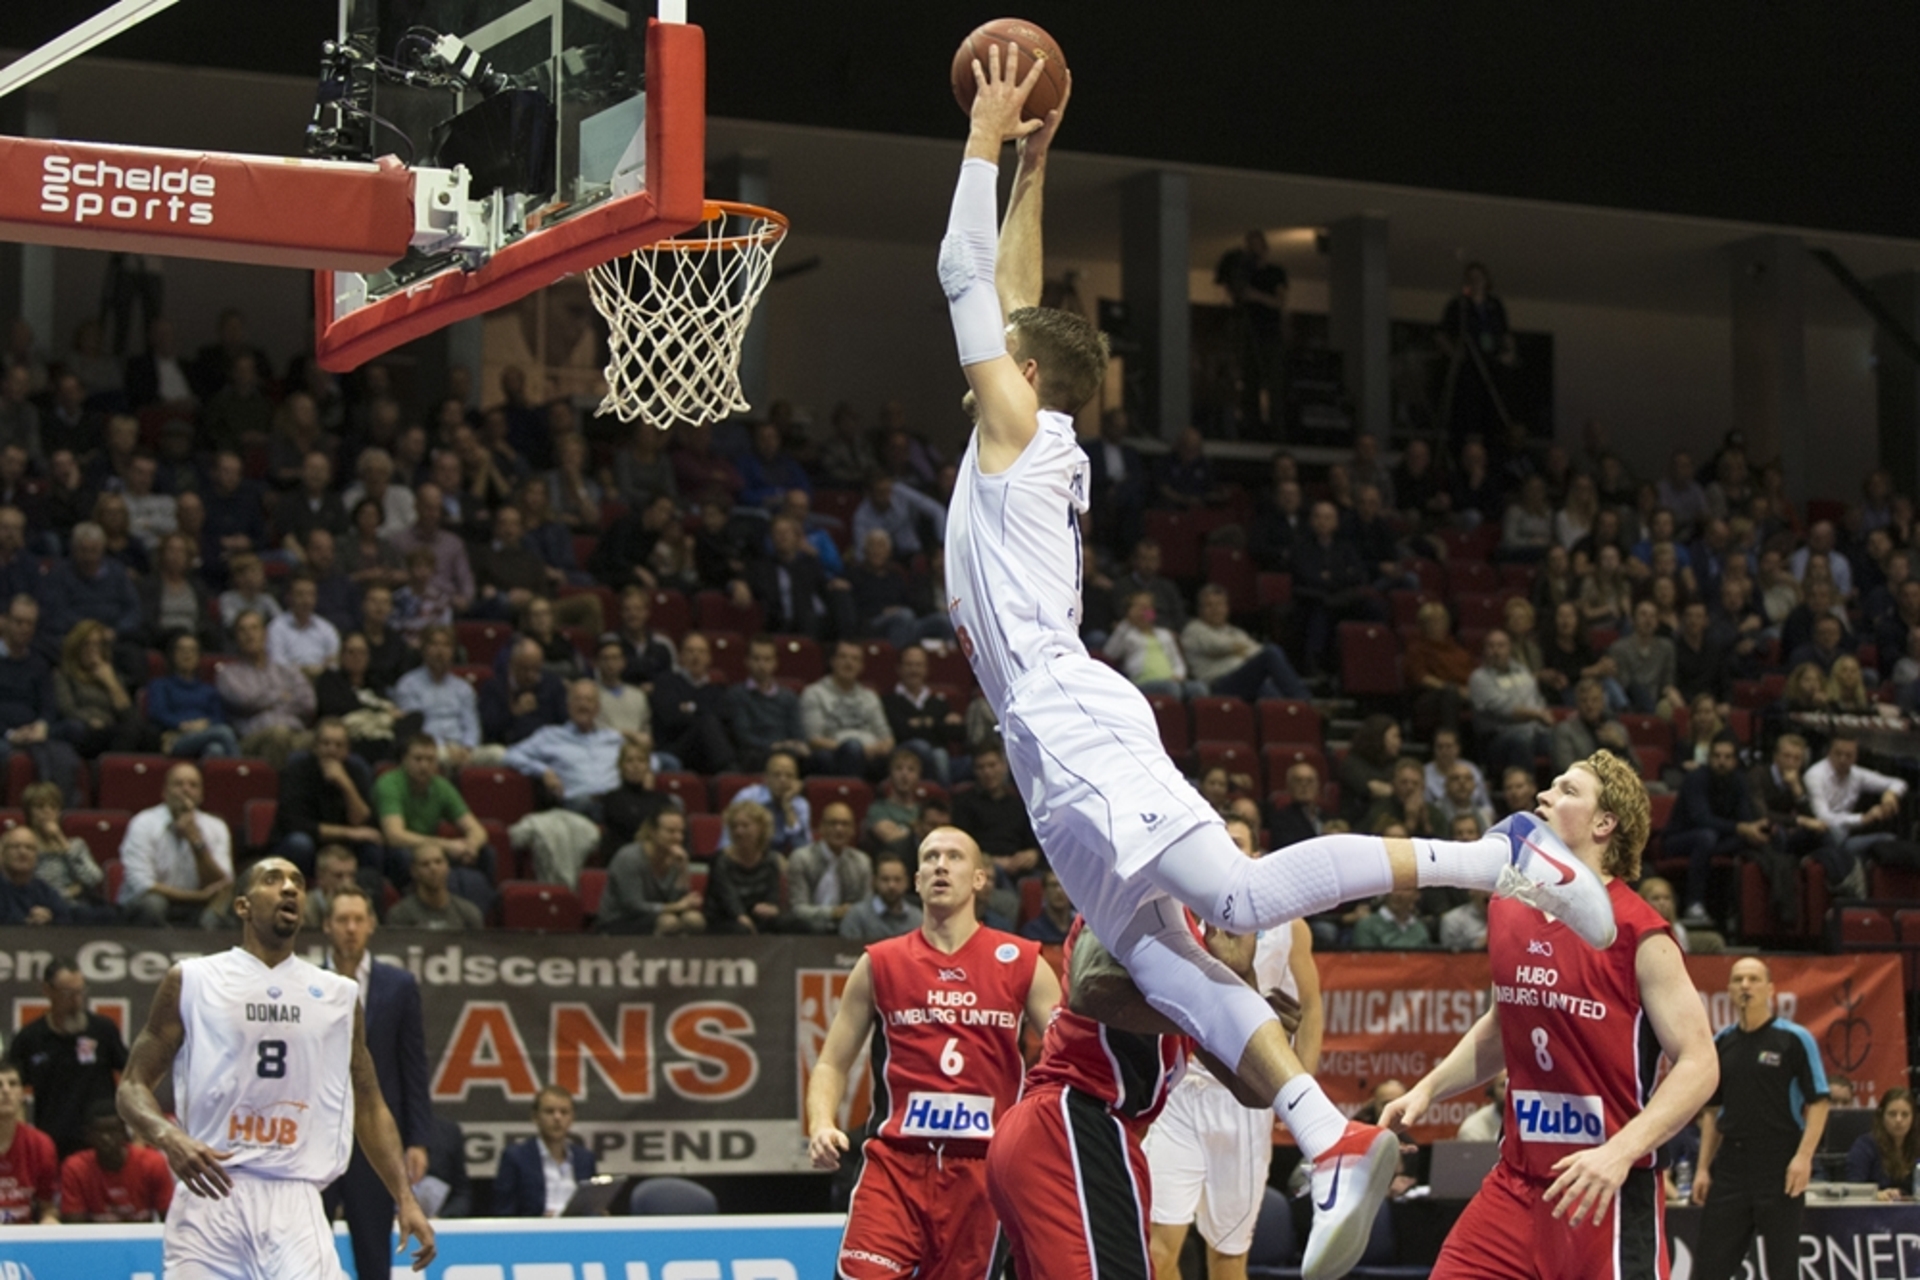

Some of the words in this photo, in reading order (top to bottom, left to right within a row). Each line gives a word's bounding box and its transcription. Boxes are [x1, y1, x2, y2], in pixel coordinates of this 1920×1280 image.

[43, 154, 216, 197] Schelde
[40, 184, 214, 225] Sports
[1516, 965, 1558, 987] HUBO
[245, 1003, 301, 1023] DONAR
[927, 990, 977, 1007] HUBO
[1542, 991, 1606, 1021] UNITED
[961, 1008, 1016, 1029] UNITED
[257, 1040, 287, 1079] 8
[940, 1038, 965, 1076] 6
[1531, 1026, 1553, 1071] 8
[1317, 1053, 1427, 1077] MGEVING
[227, 1114, 298, 1146] HUB
[904, 1099, 991, 1132] Hubo
[1515, 1099, 1603, 1137] Hubo
